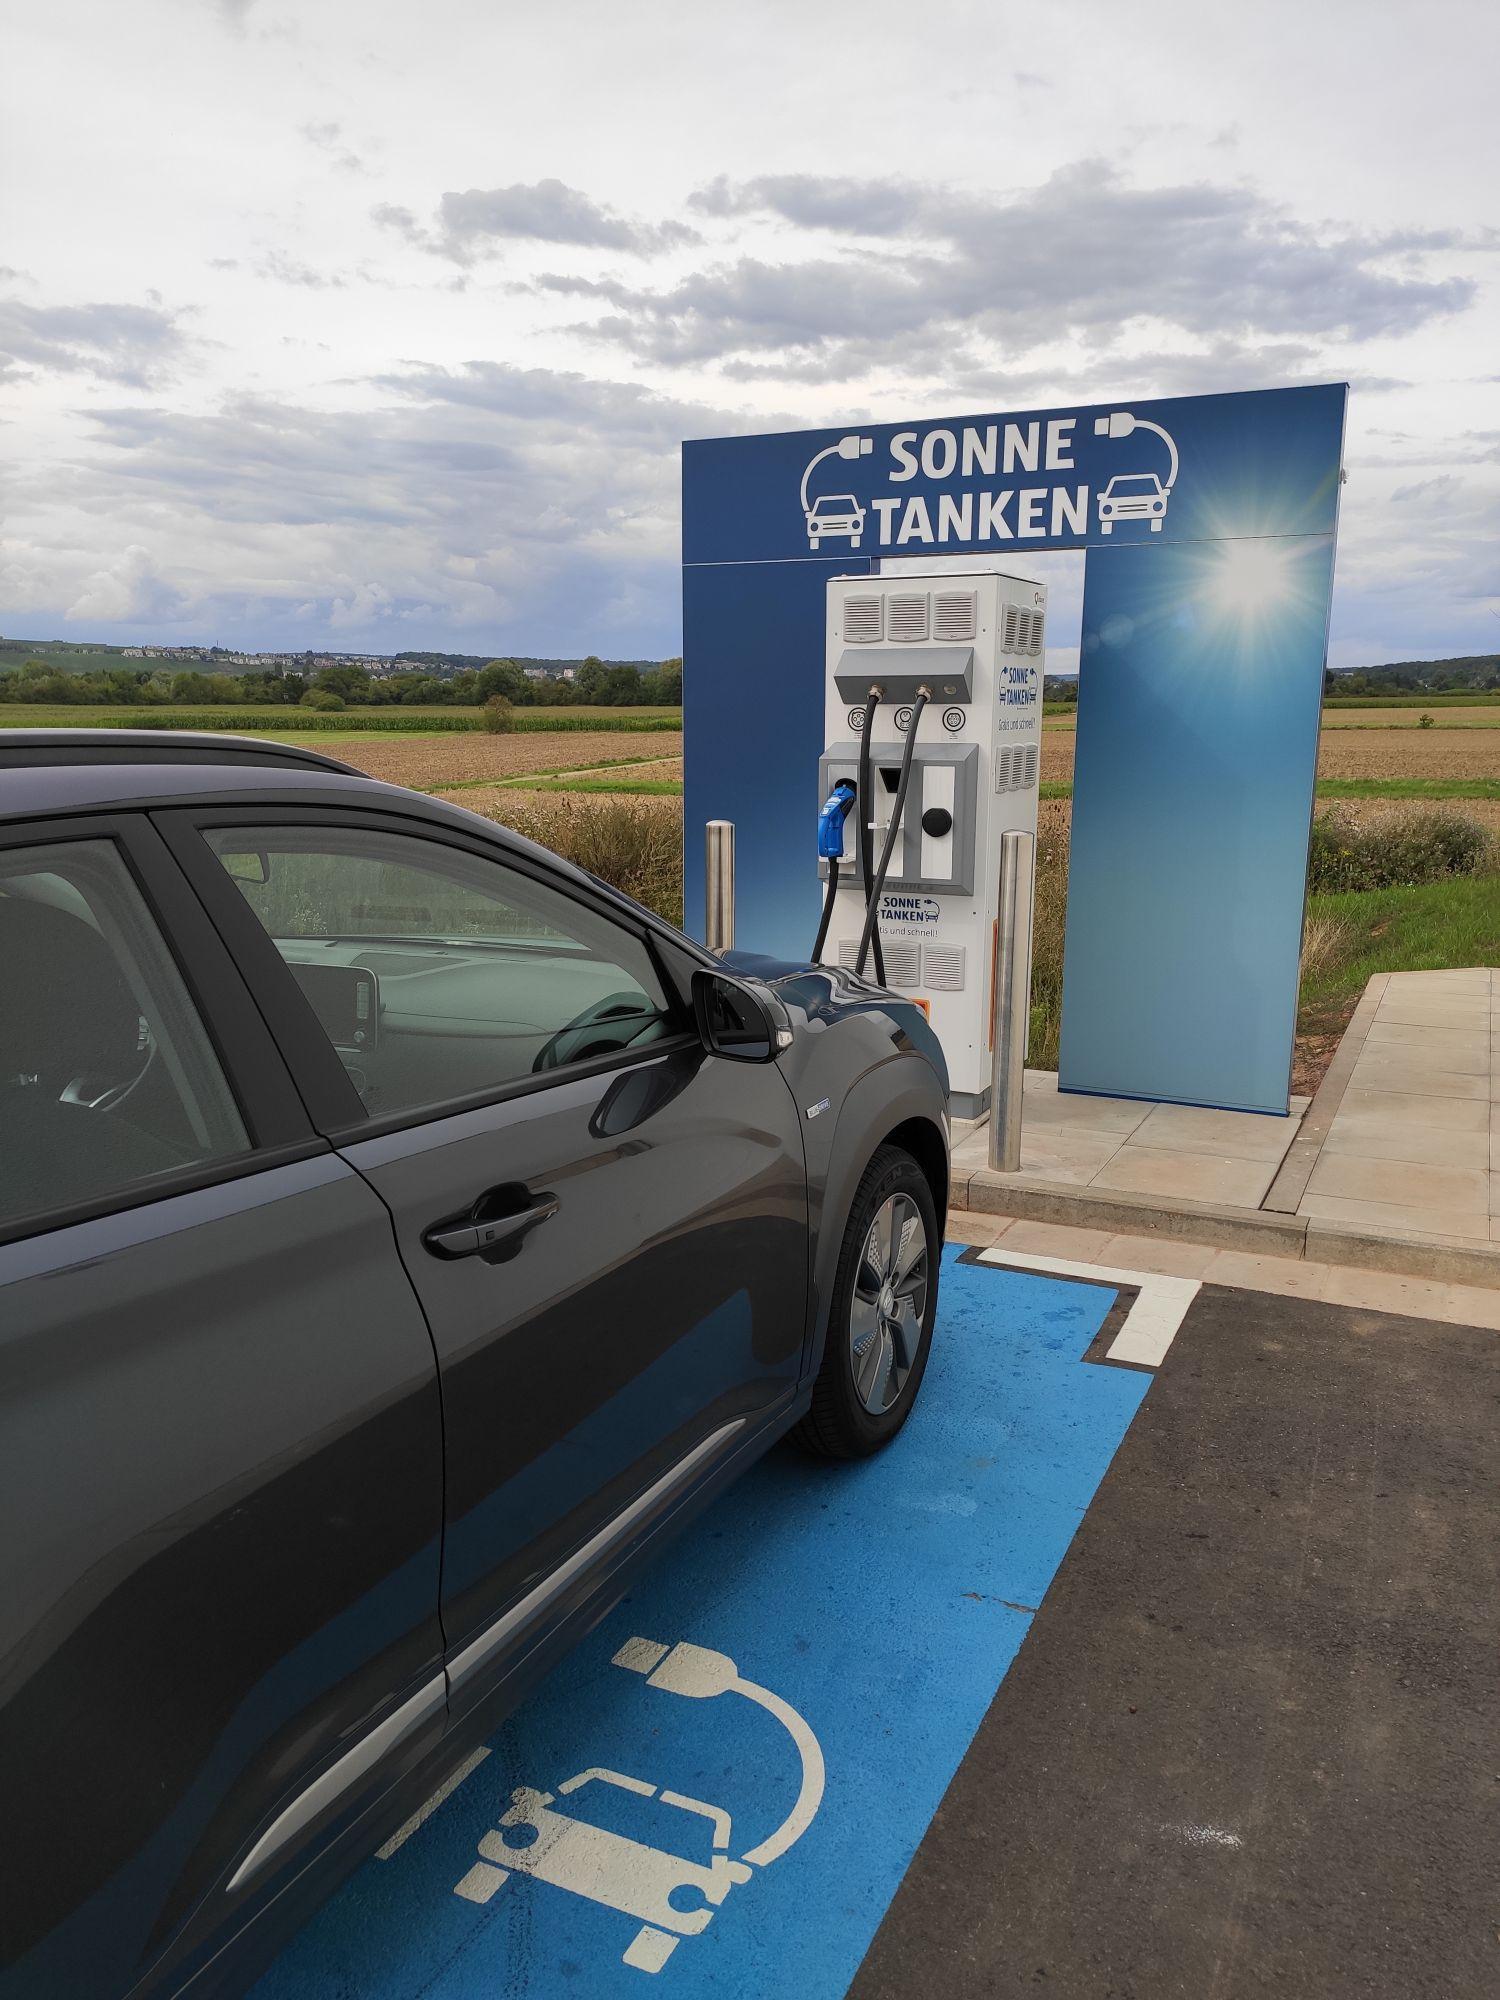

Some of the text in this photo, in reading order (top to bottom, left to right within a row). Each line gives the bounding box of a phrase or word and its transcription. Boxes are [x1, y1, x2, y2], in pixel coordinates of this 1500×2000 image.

[888, 418, 1077, 482] SONNE
[871, 485, 1089, 546] TANKEN
[1009, 667, 1028, 683] SONNE
[1006, 689, 1029, 705] TANKEN
[883, 897, 921, 909] SONNE
[880, 909, 924, 922] TANKEN
[890, 927, 906, 936] und
[907, 928, 938, 938] schnell!
